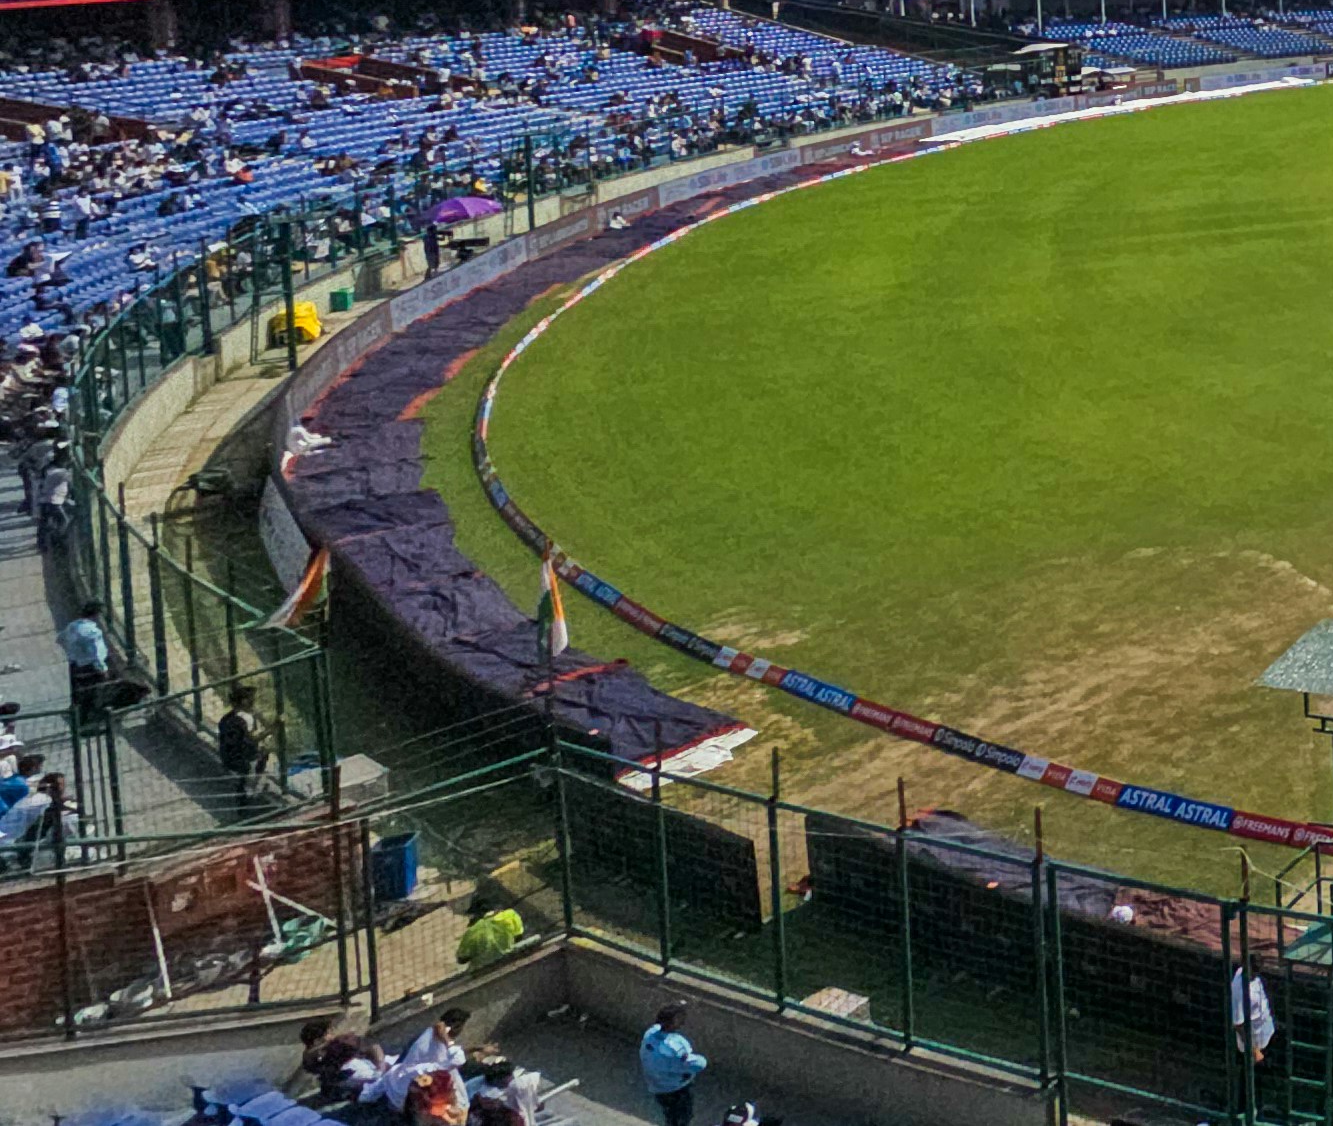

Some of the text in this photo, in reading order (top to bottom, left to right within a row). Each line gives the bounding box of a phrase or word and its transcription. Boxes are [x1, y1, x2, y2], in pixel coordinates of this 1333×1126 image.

[783, 671, 854, 712] ASTRAL ASTRAL
[1120, 785, 1228, 829] ASTRAL ASTRAL
[1242, 816, 1291, 839] FREEMANS
